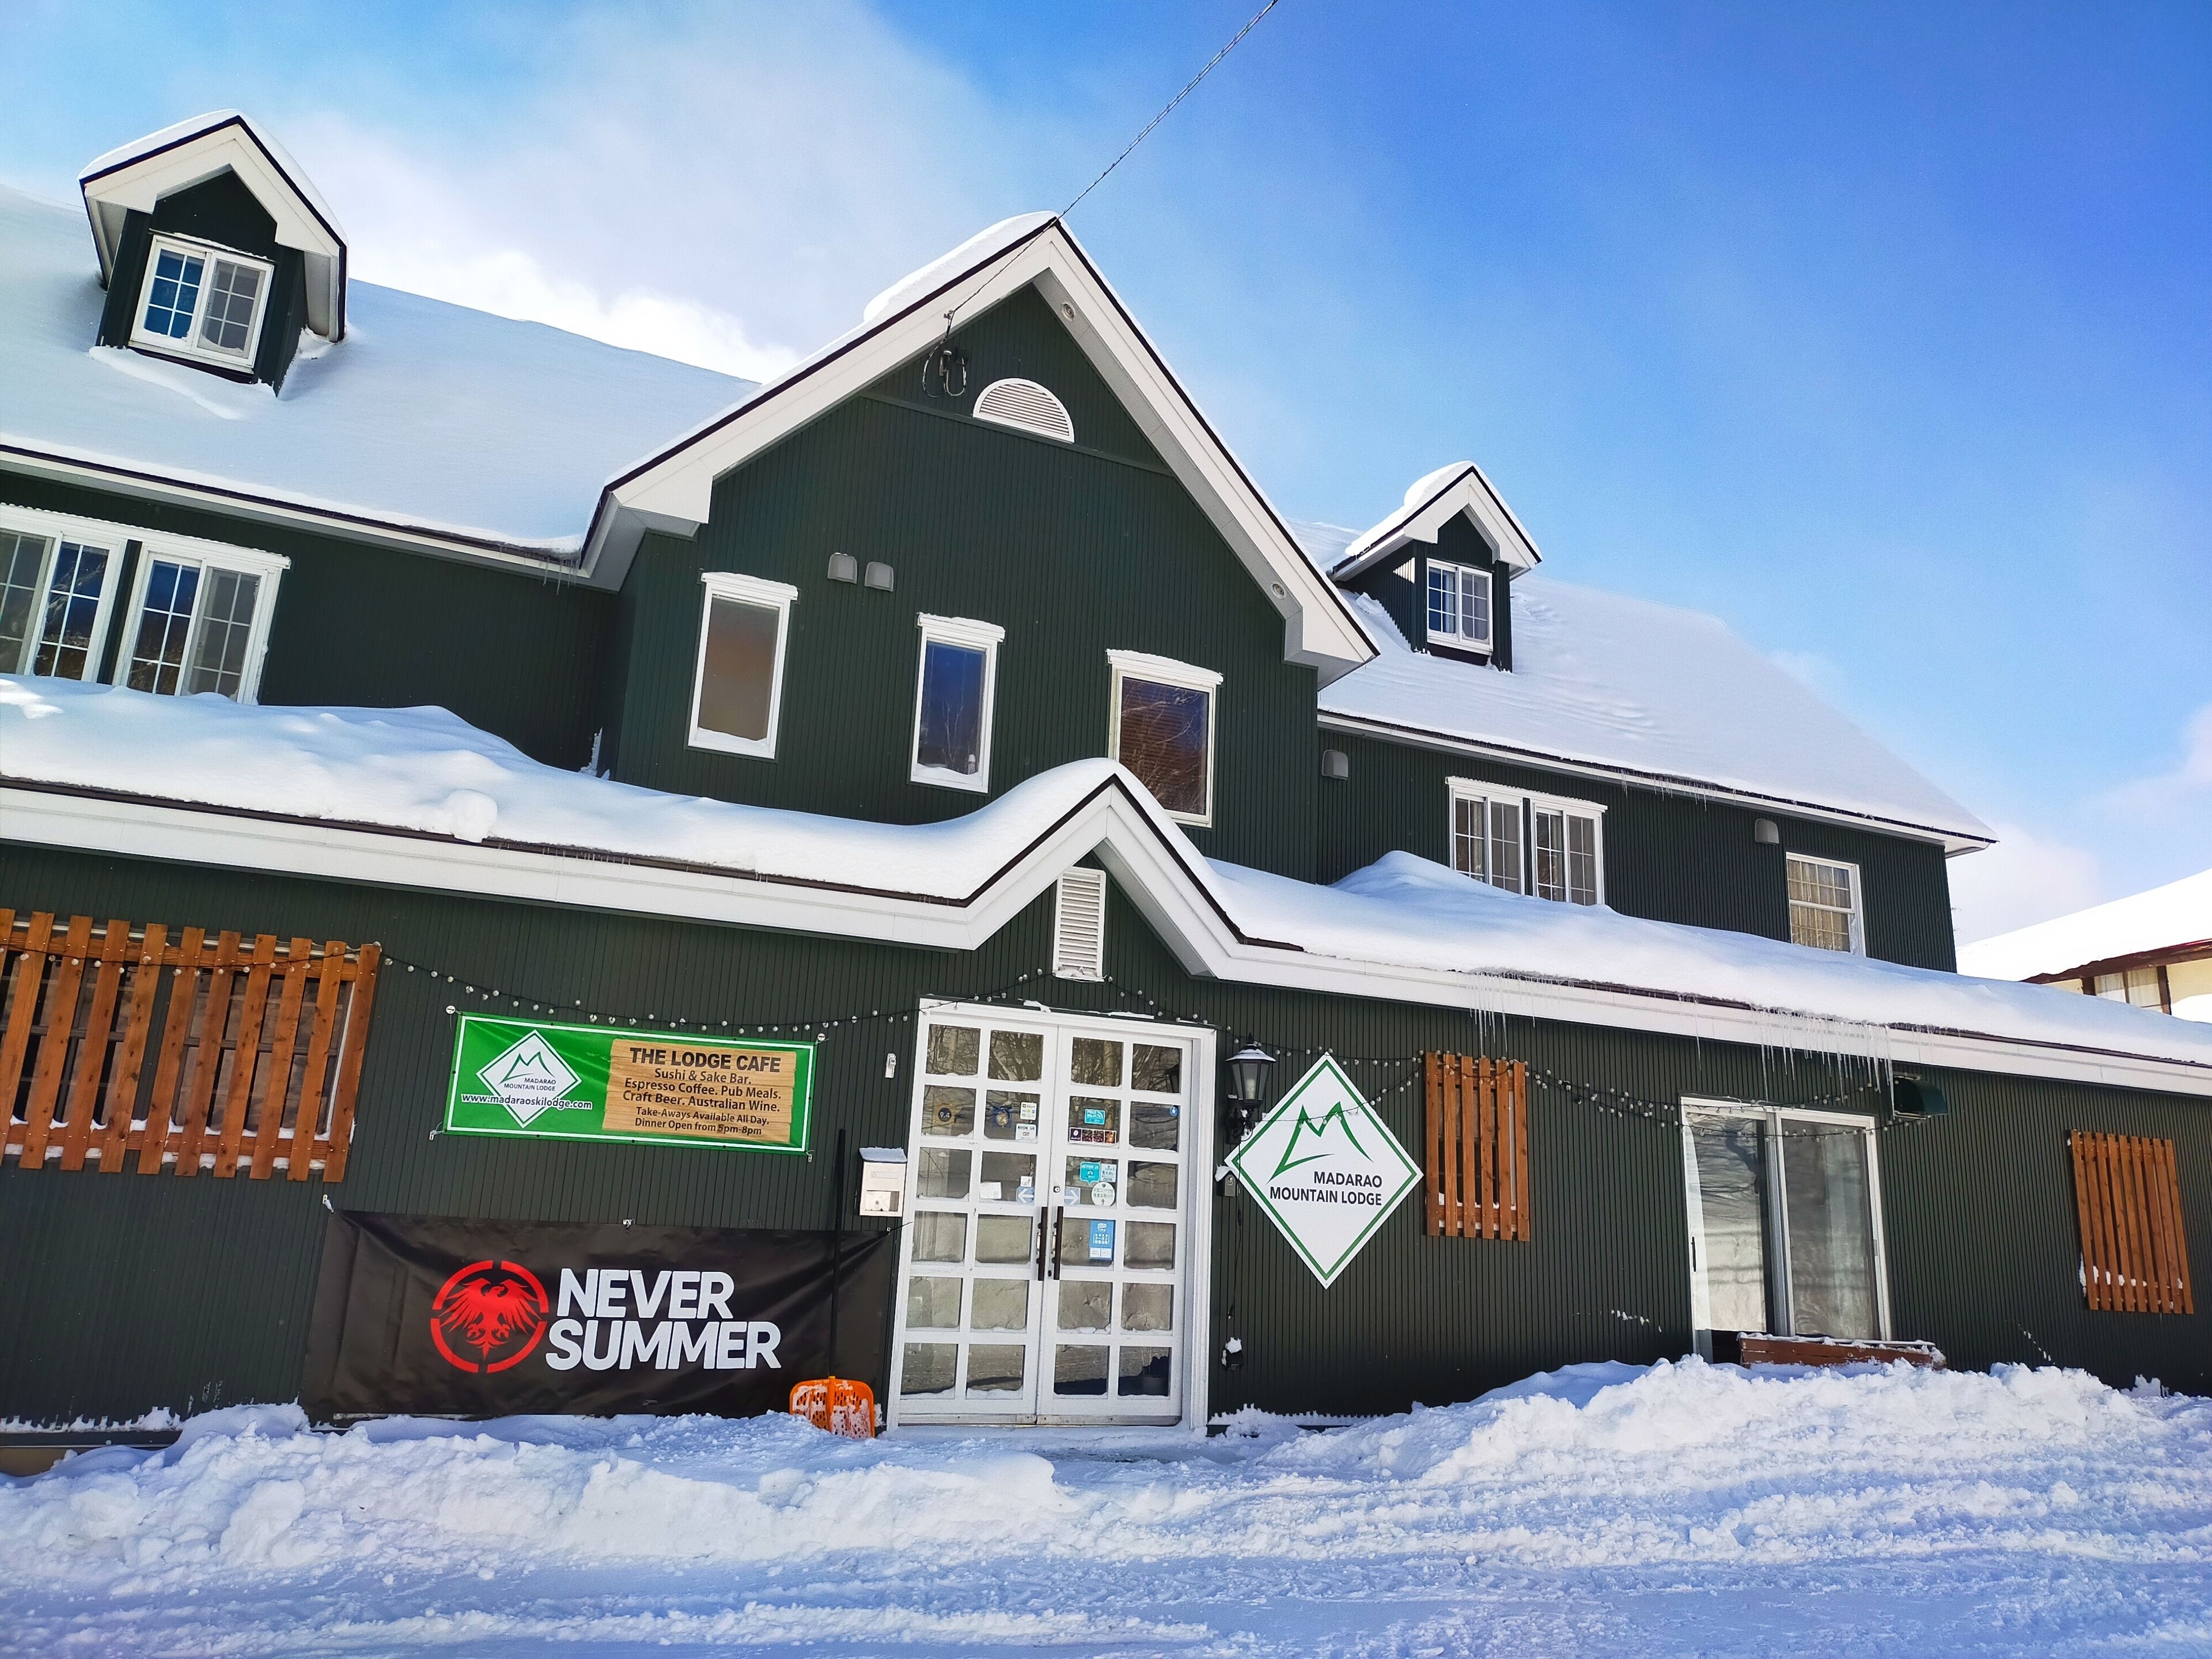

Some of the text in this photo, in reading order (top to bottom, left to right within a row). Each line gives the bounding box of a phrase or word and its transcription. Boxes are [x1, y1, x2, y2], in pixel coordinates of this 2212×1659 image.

[630, 1047, 781, 1073] THE LODGE CAFE
[654, 1068, 751, 1085] Sushi & Sake Bar.
[624, 1078, 781, 1099] Espresso Coffee. Pub Meals.
[462, 1094, 592, 1109] www.madaraoskilodge.com
[623, 1090, 780, 1112] Craft Beer. Australian Wine.
[636, 1107, 769, 1126] Take-Aways Available All Day.
[635, 1118, 762, 1136] Dinner Open from 5pm-8pm
[1314, 1171, 1382, 1188] MADARAO
[1270, 1186, 1382, 1206] MOUNTAIN LODGE
[556, 1268, 734, 1319] NEVER
[545, 1319, 782, 1370] SUMMER
